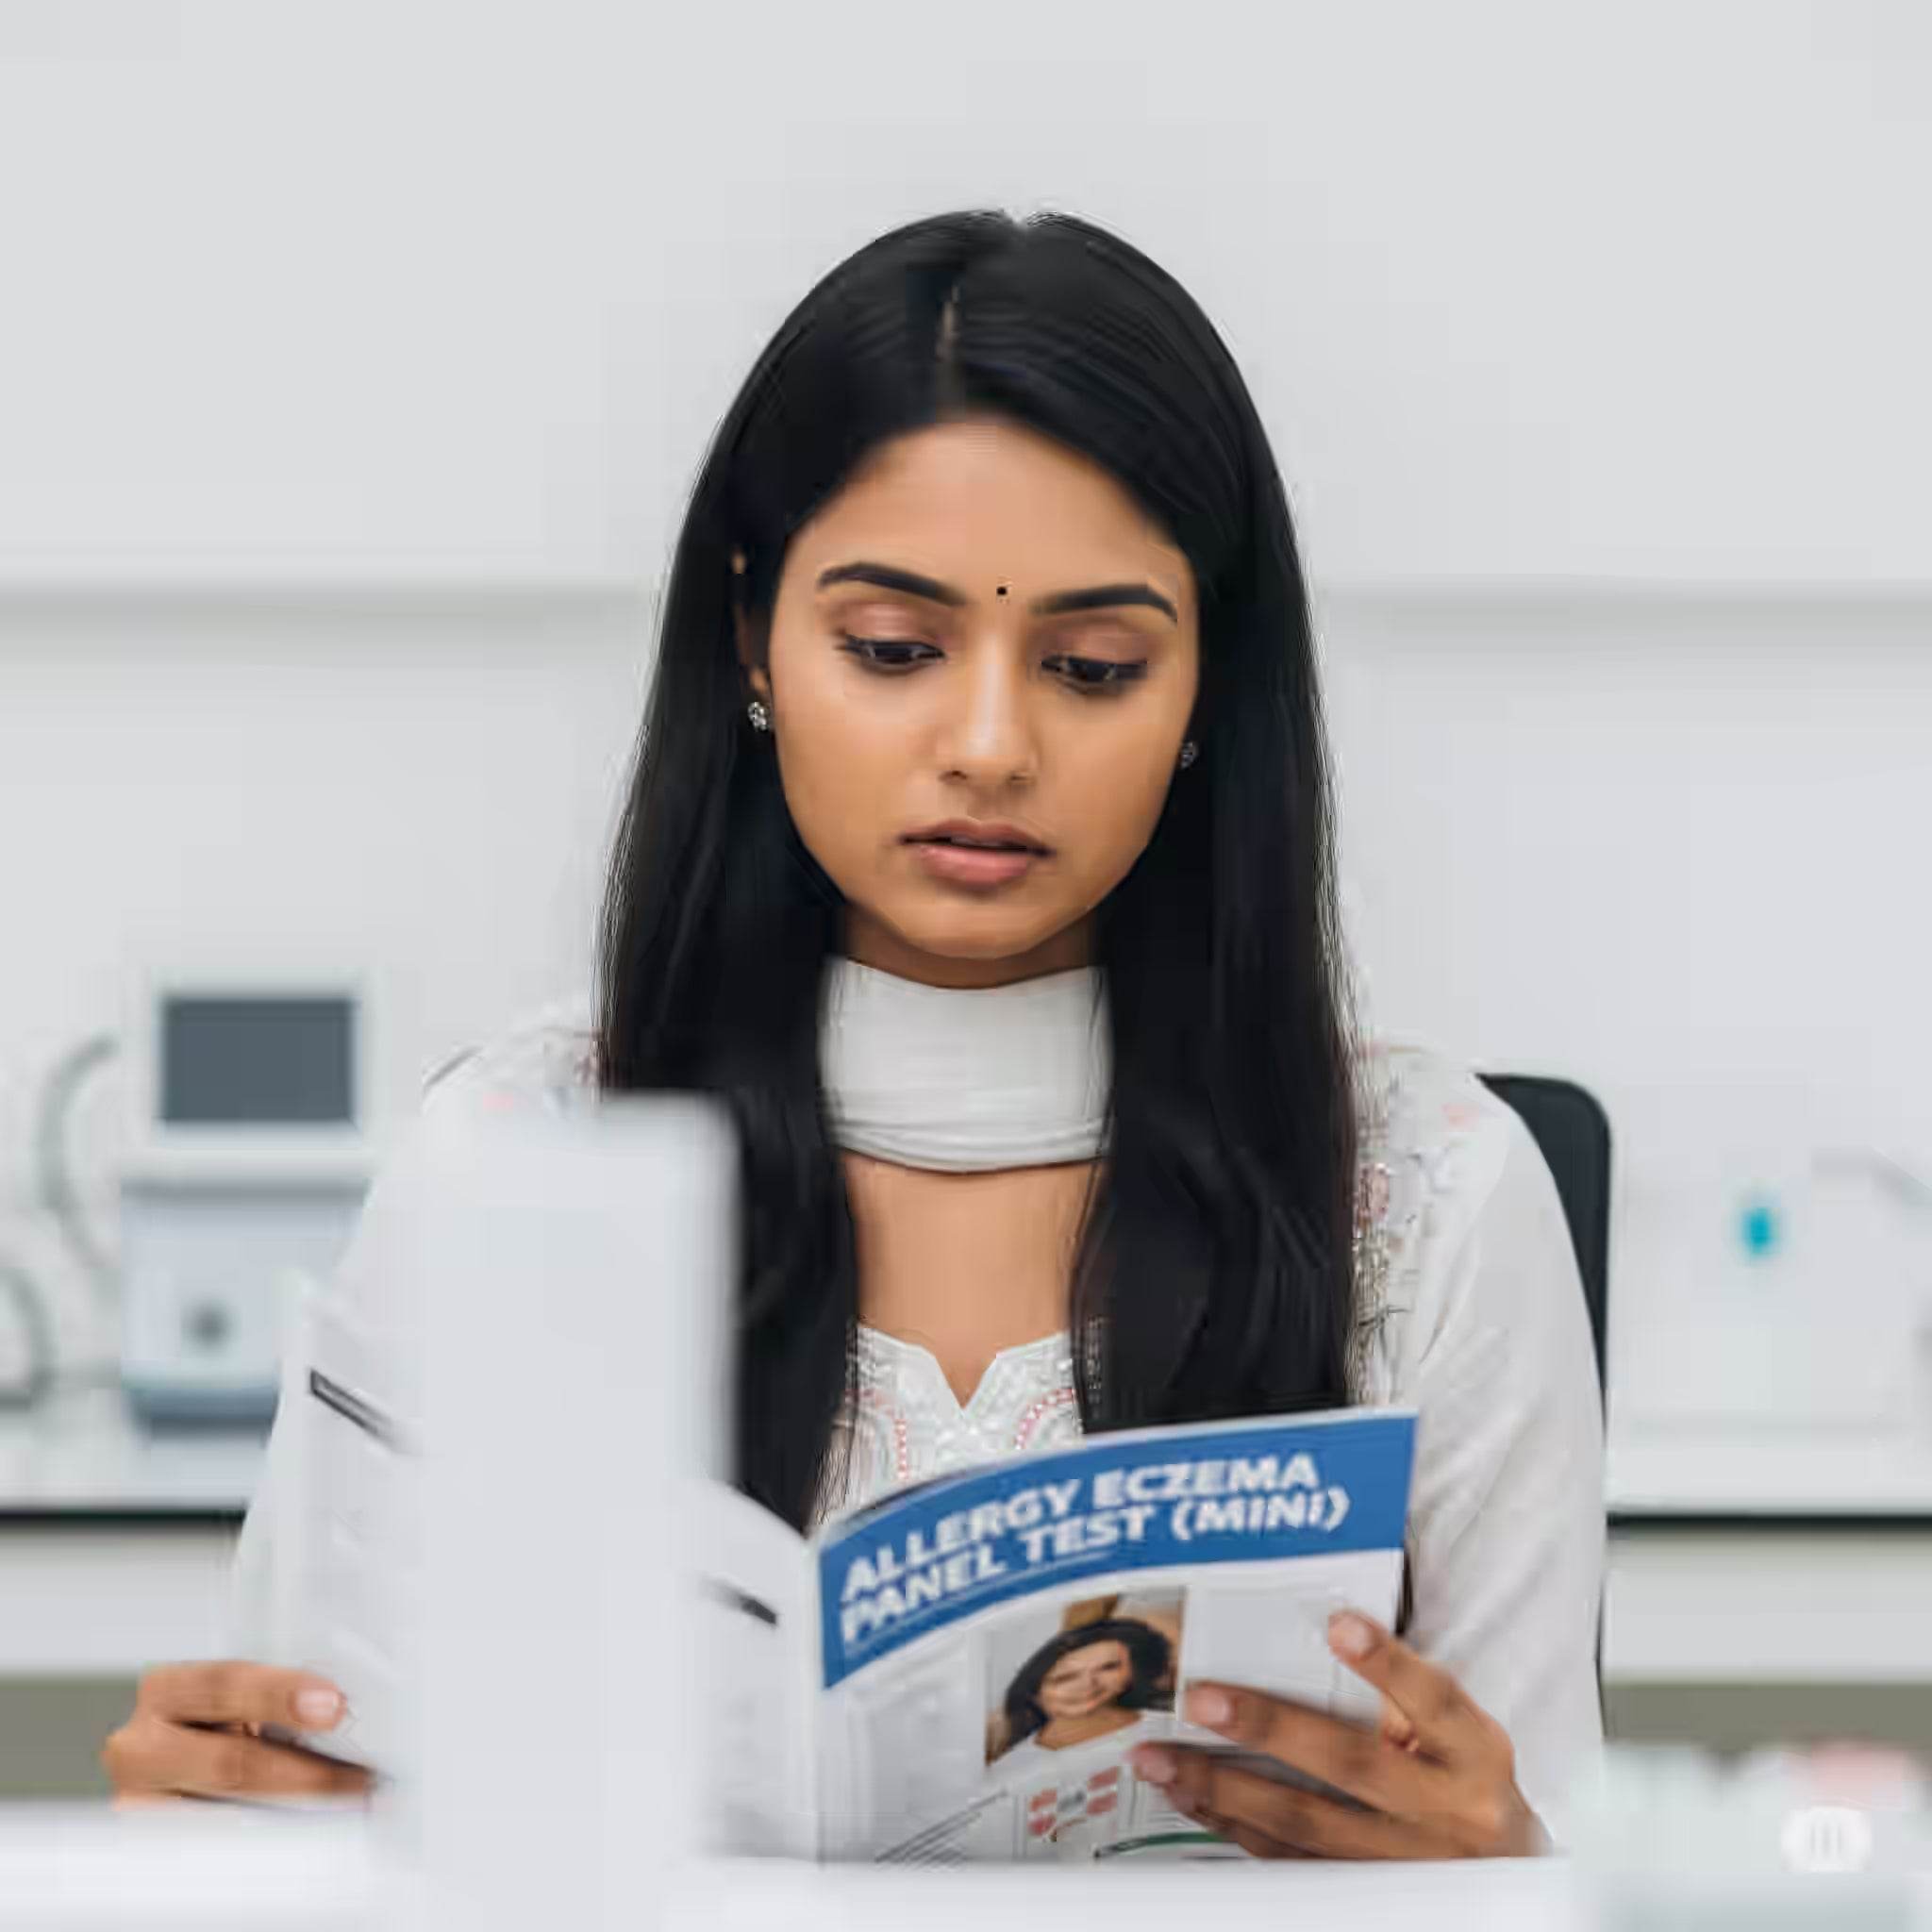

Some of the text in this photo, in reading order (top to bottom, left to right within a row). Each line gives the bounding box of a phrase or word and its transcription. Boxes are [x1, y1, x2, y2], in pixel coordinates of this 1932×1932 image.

[840, 1554, 1008, 1641] PANEL
[1022, 1504, 1158, 1563] TEST
[1170, 1488, 1351, 1541] (MINI)
[841, 1453, 1319, 1603] ALLERGY ECZEMA
